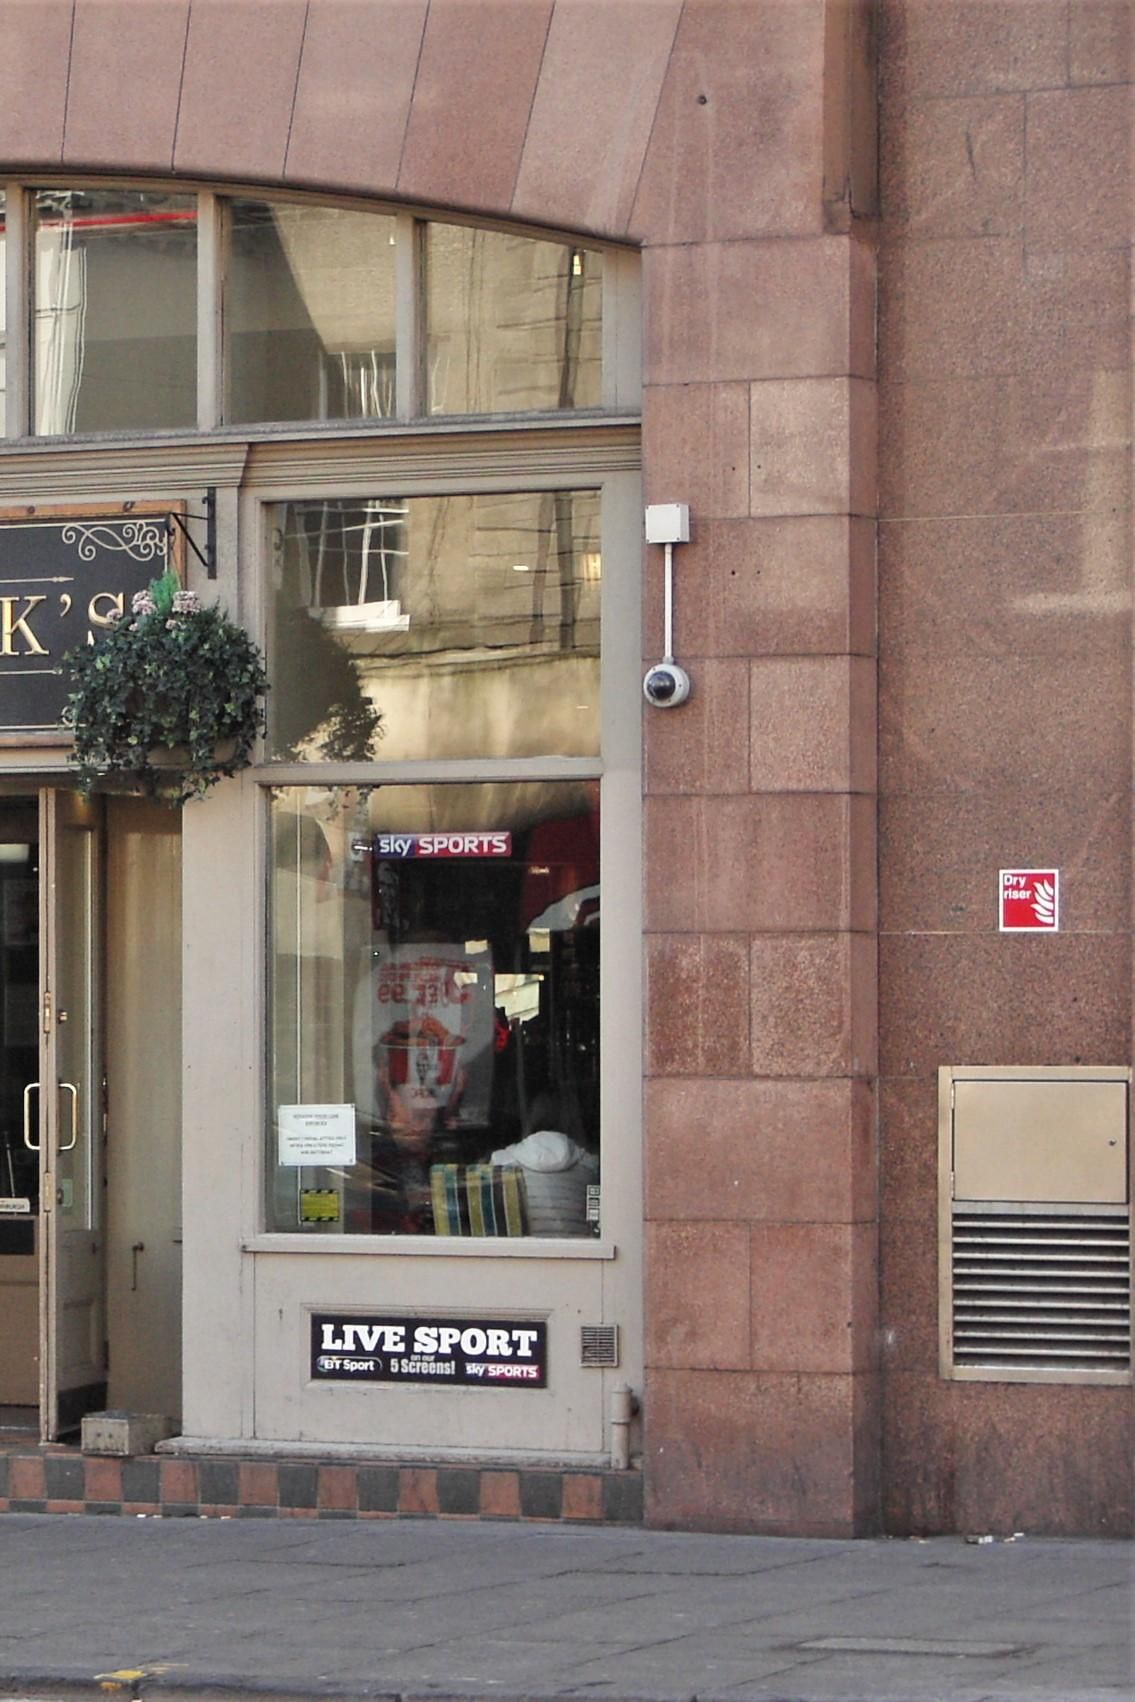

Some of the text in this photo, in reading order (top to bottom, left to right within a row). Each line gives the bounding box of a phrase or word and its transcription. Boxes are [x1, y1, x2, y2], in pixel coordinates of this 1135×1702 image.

[379, 835, 507, 857] sky SPORTS
[1004, 874, 1027, 888] Dry
[1004, 888, 1032, 900] riser
[321, 1324, 538, 1356] LIVE SPORT
[324, 1358, 375, 1372] BT Sport
[390, 1359, 456, 1375] 5 Screens!
[466, 1364, 538, 1378] sky SPORTS
